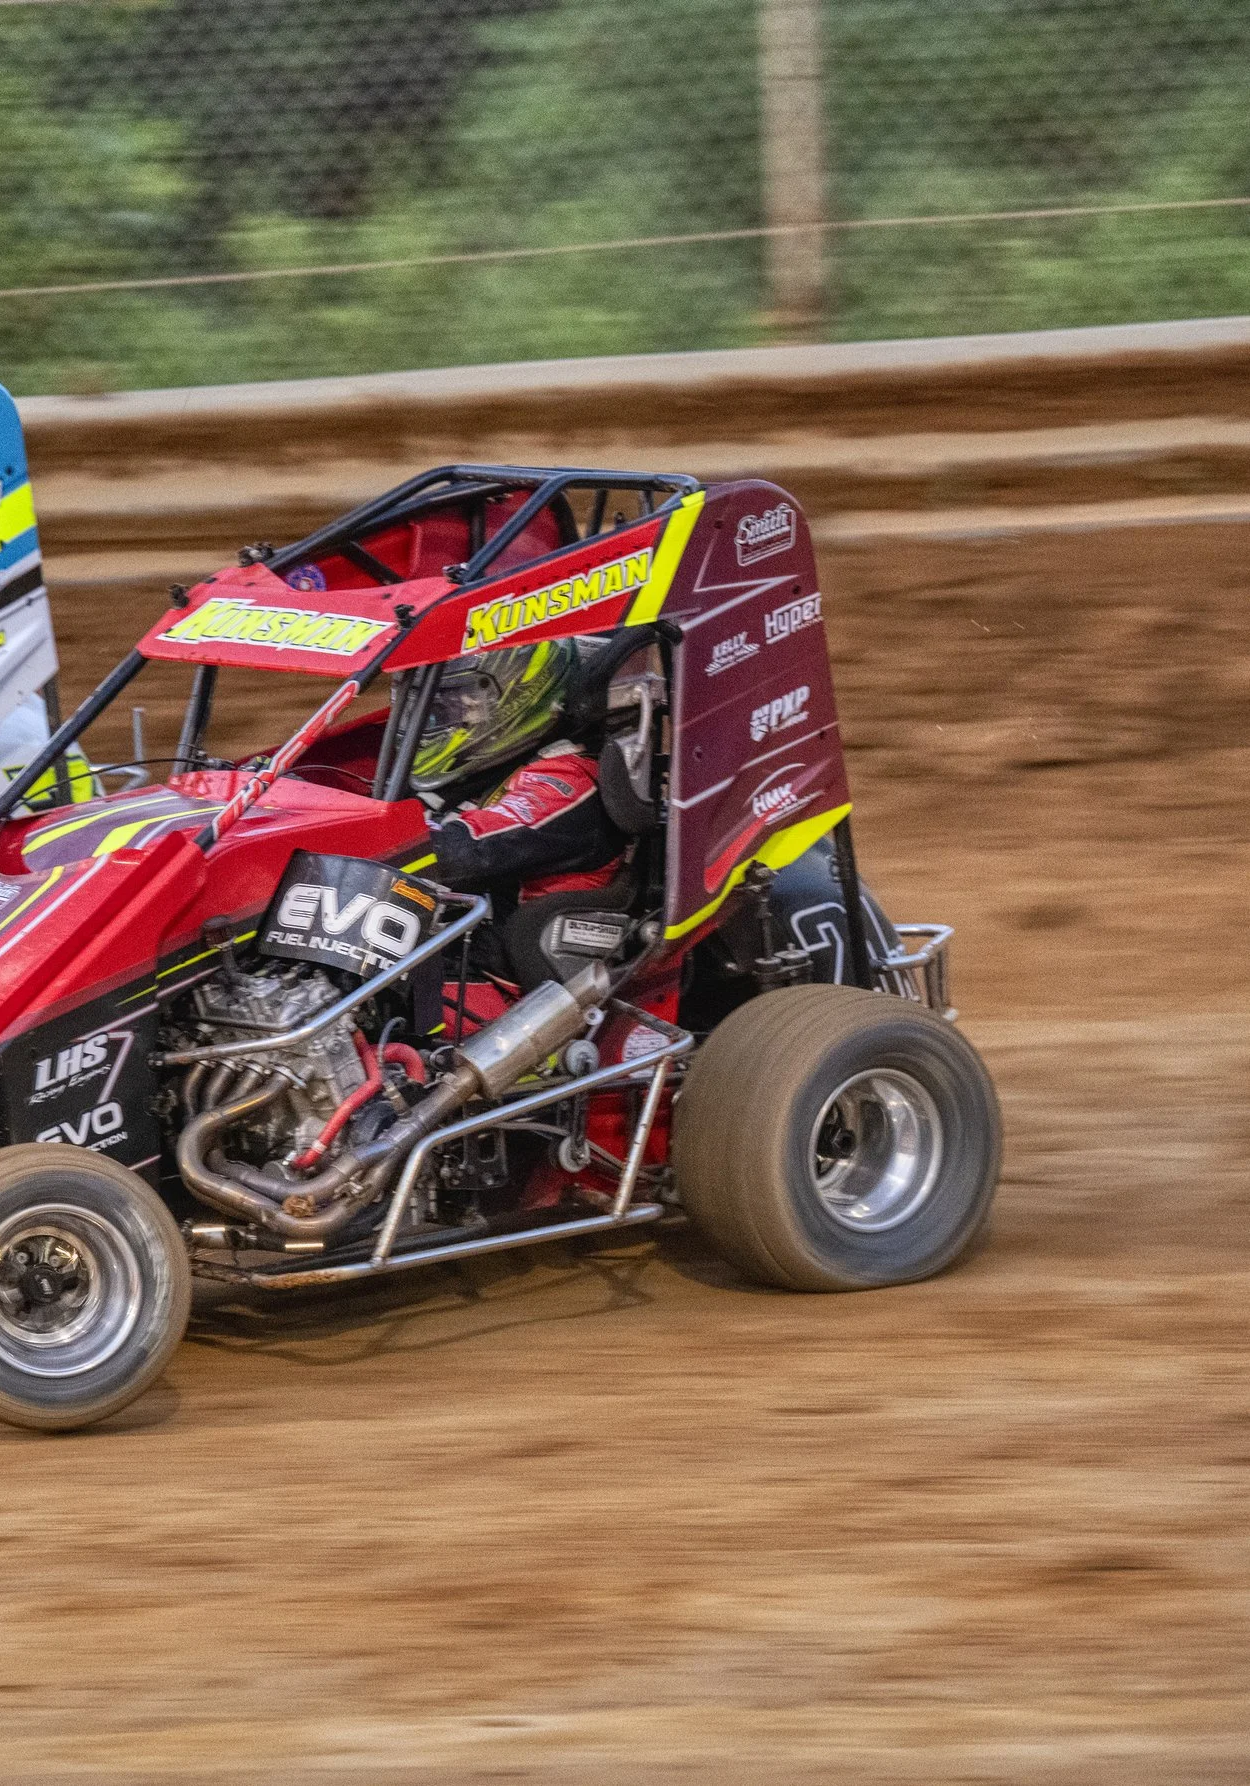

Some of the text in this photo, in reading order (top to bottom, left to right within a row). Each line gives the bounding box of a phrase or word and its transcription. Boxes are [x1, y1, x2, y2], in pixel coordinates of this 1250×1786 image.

[161, 599, 390, 656] KUNSMAN
[466, 550, 652, 651] KUNSMAN
[266, 931, 308, 948] FUEL
[277, 882, 422, 960] EVO
[35, 1034, 109, 1091] LHS
